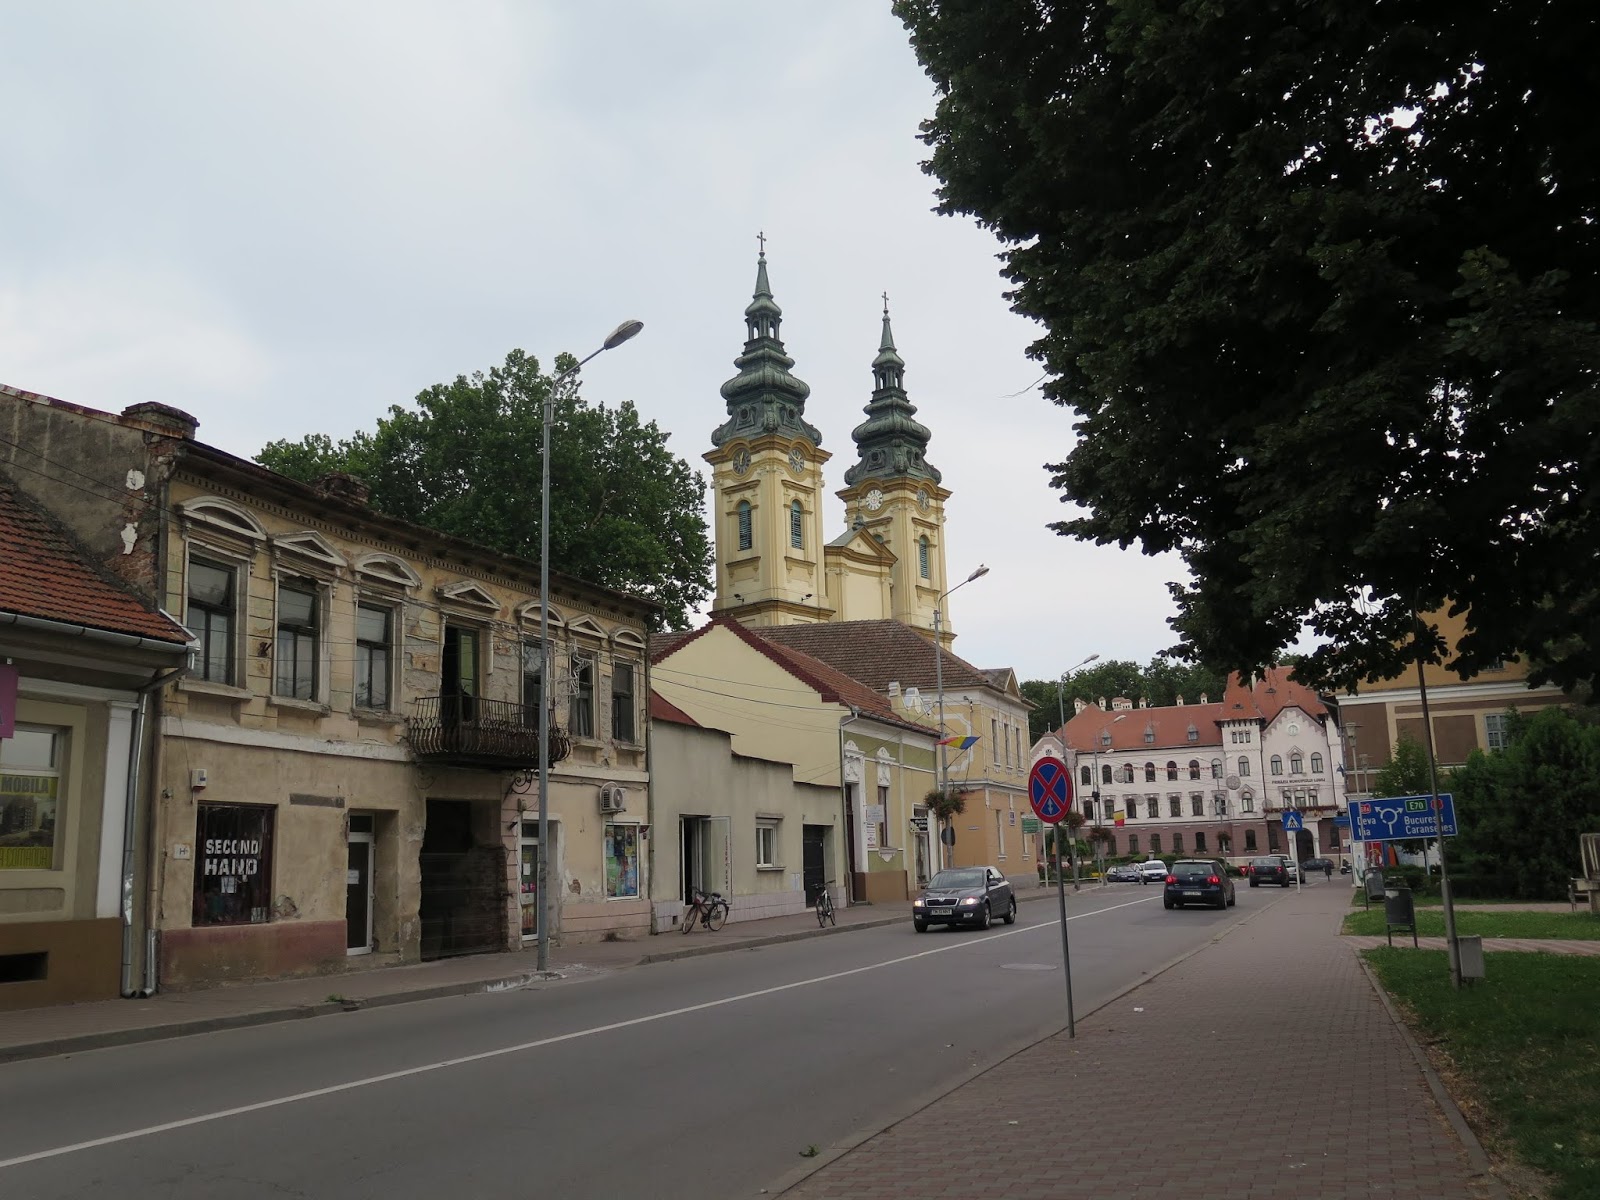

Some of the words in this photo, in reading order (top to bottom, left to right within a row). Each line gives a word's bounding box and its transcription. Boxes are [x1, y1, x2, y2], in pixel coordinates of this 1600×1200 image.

[1, 776, 49, 794] MOBILA
[1409, 801, 1424, 810] E70
[1356, 816, 1377, 826] Deva
[205, 839, 259, 855] SECOND
[204, 858, 258, 876] HAND
